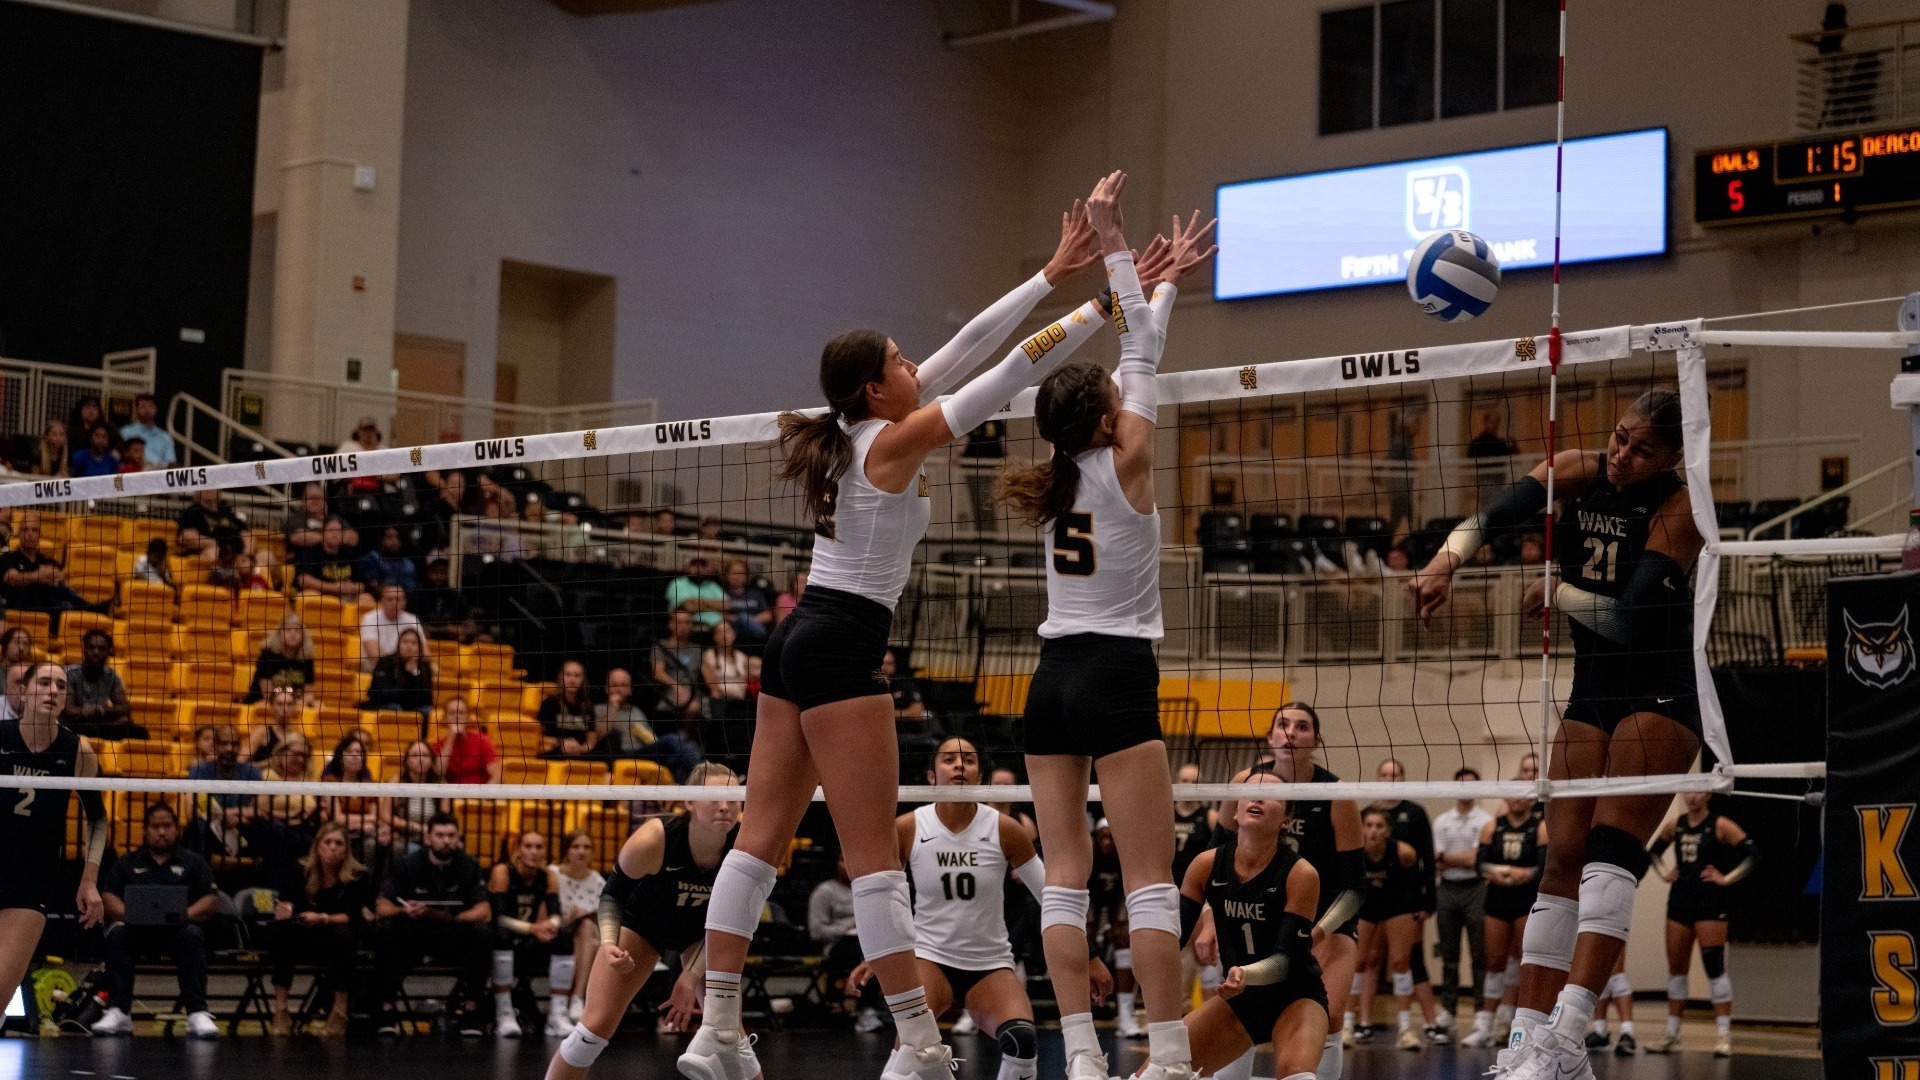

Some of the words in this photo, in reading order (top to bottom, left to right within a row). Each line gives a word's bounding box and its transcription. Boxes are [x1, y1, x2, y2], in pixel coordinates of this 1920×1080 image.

[1712, 150, 1760, 174] OWLS
[1728, 180, 1745, 211] 5
[1487, 239, 1537, 262] ANK
[1661, 325, 1688, 335] Senoh
[1021, 322, 1067, 364] HOO
[1341, 350, 1420, 380] OWLS
[655, 420, 711, 444] OWLS
[475, 438, 525, 461] OWLS
[312, 454, 358, 475] OWLS
[34, 480, 72, 499] OWLS
[166, 468, 207, 487] OWLS
[1578, 509, 1627, 537] WAKE
[1053, 512, 1097, 578] 5
[1582, 537, 1619, 583] 21
[13, 787, 36, 817] 2
[936, 851, 979, 867] WAKE
[940, 872, 976, 901] 10
[675, 892, 712, 907] 17
[1224, 899, 1266, 921] WAKE
[1240, 922, 1255, 955] 1
